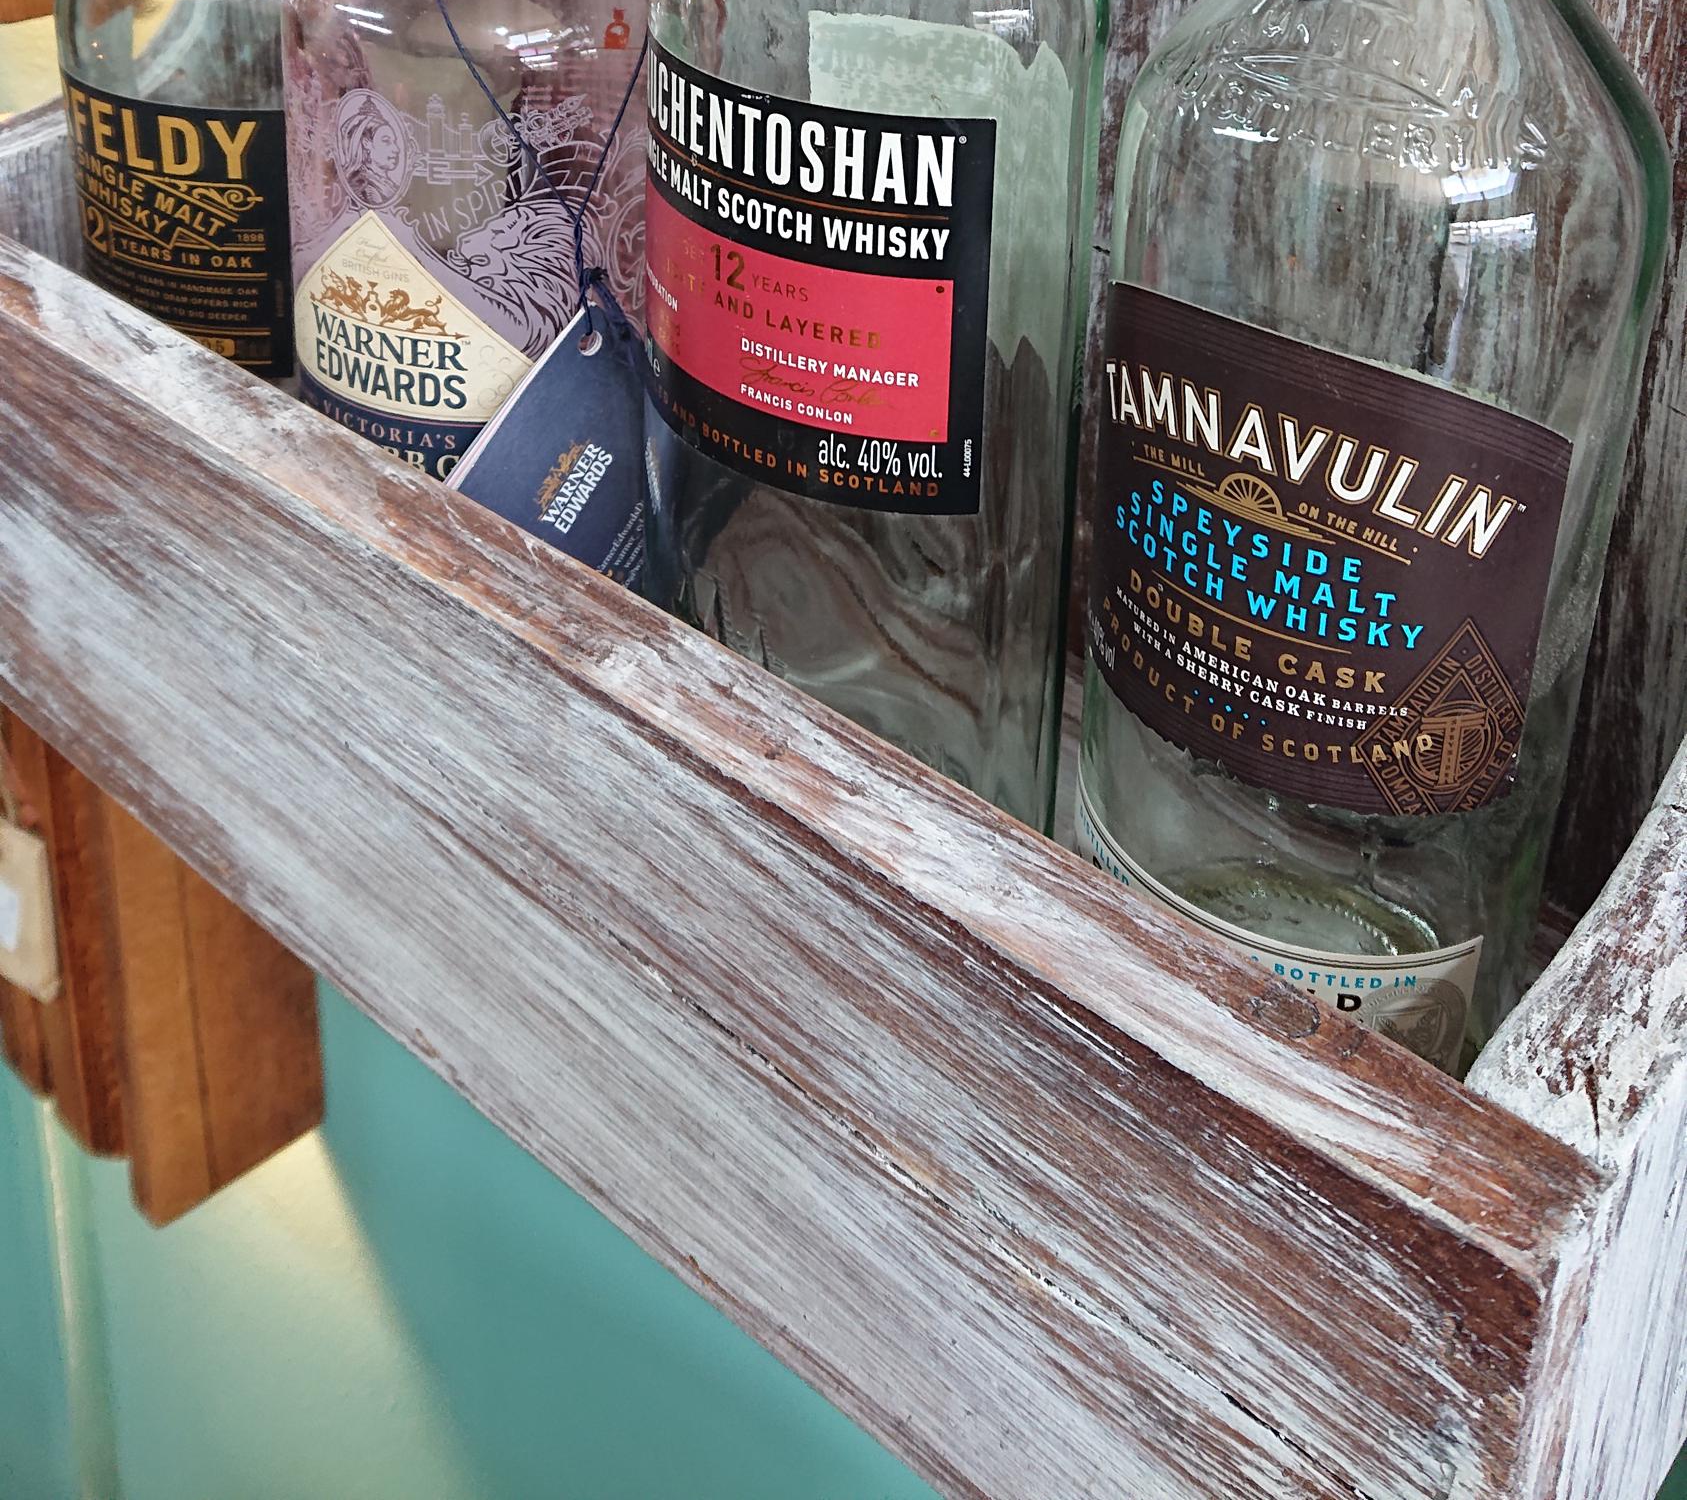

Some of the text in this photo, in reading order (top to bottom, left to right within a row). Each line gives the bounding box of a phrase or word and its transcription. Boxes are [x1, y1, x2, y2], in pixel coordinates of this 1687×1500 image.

[69, 85, 257, 180] FELDY
[648, 46, 954, 207] UCHENTOSHAN
[88, 175, 168, 234] WHISKY
[154, 191, 225, 237] MALT
[422, 162, 527, 242] IN SPIRIT
[670, 159, 712, 209] MALT
[717, 187, 813, 244] SCOTCH
[823, 216, 951, 261] WHISKY
[121, 238, 172, 262] YEARS
[181, 255, 200, 266] IN
[210, 255, 253, 268] OAK
[710, 243, 745, 292] 12
[751, 273, 809, 302] YEARS
[312, 301, 468, 372] WARNER
[714, 290, 882, 349] AND LAYERED
[316, 337, 468, 410] EDWARDS
[741, 337, 920, 388] DISTILLERY MANAGER
[323, 399, 456, 449] VICTORIA'S
[740, 383, 854, 424] FRANCIS CONLON
[541, 443, 602, 524] WARNER
[553, 449, 614, 534] EDWARDS
[702, 421, 777, 469] BOTTLED
[787, 459, 808, 478] IN
[818, 468, 939, 497] SCOTLAND
[818, 433, 943, 479] alc. 40% vol.
[1106, 359, 1517, 558] TAMNAVULIN
[1143, 443, 1398, 552] THE MILL ON THE HILL
[1151, 479, 1362, 583] SPEYSIDE
[1116, 504, 1424, 649] SCOTCH WHISKY
[1130, 491, 1396, 617] SINGLE MALT
[1116, 585, 1160, 634] MATURED
[1163, 629, 1176, 645] IN
[1182, 640, 1279, 693] AMERICAN
[1285, 684, 1326, 707] OAK
[1331, 698, 1409, 717] BARRELS
[1130, 568, 1252, 661] DOUBLE
[1277, 652, 1386, 694] CASK
[1102, 595, 1195, 714] PRODUCT
[1211, 713, 1245, 740] OF
[1260, 733, 1433, 764] SCOTLAND
[1133, 621, 1368, 731] WITH A SHERRY CASK FINISH
[1373, 653, 1520, 747] TAMNAVULIN DISTILLERY
[1375, 740, 1514, 816] COMPA MITED
[1273, 963, 1417, 989] BOTTLED IN
